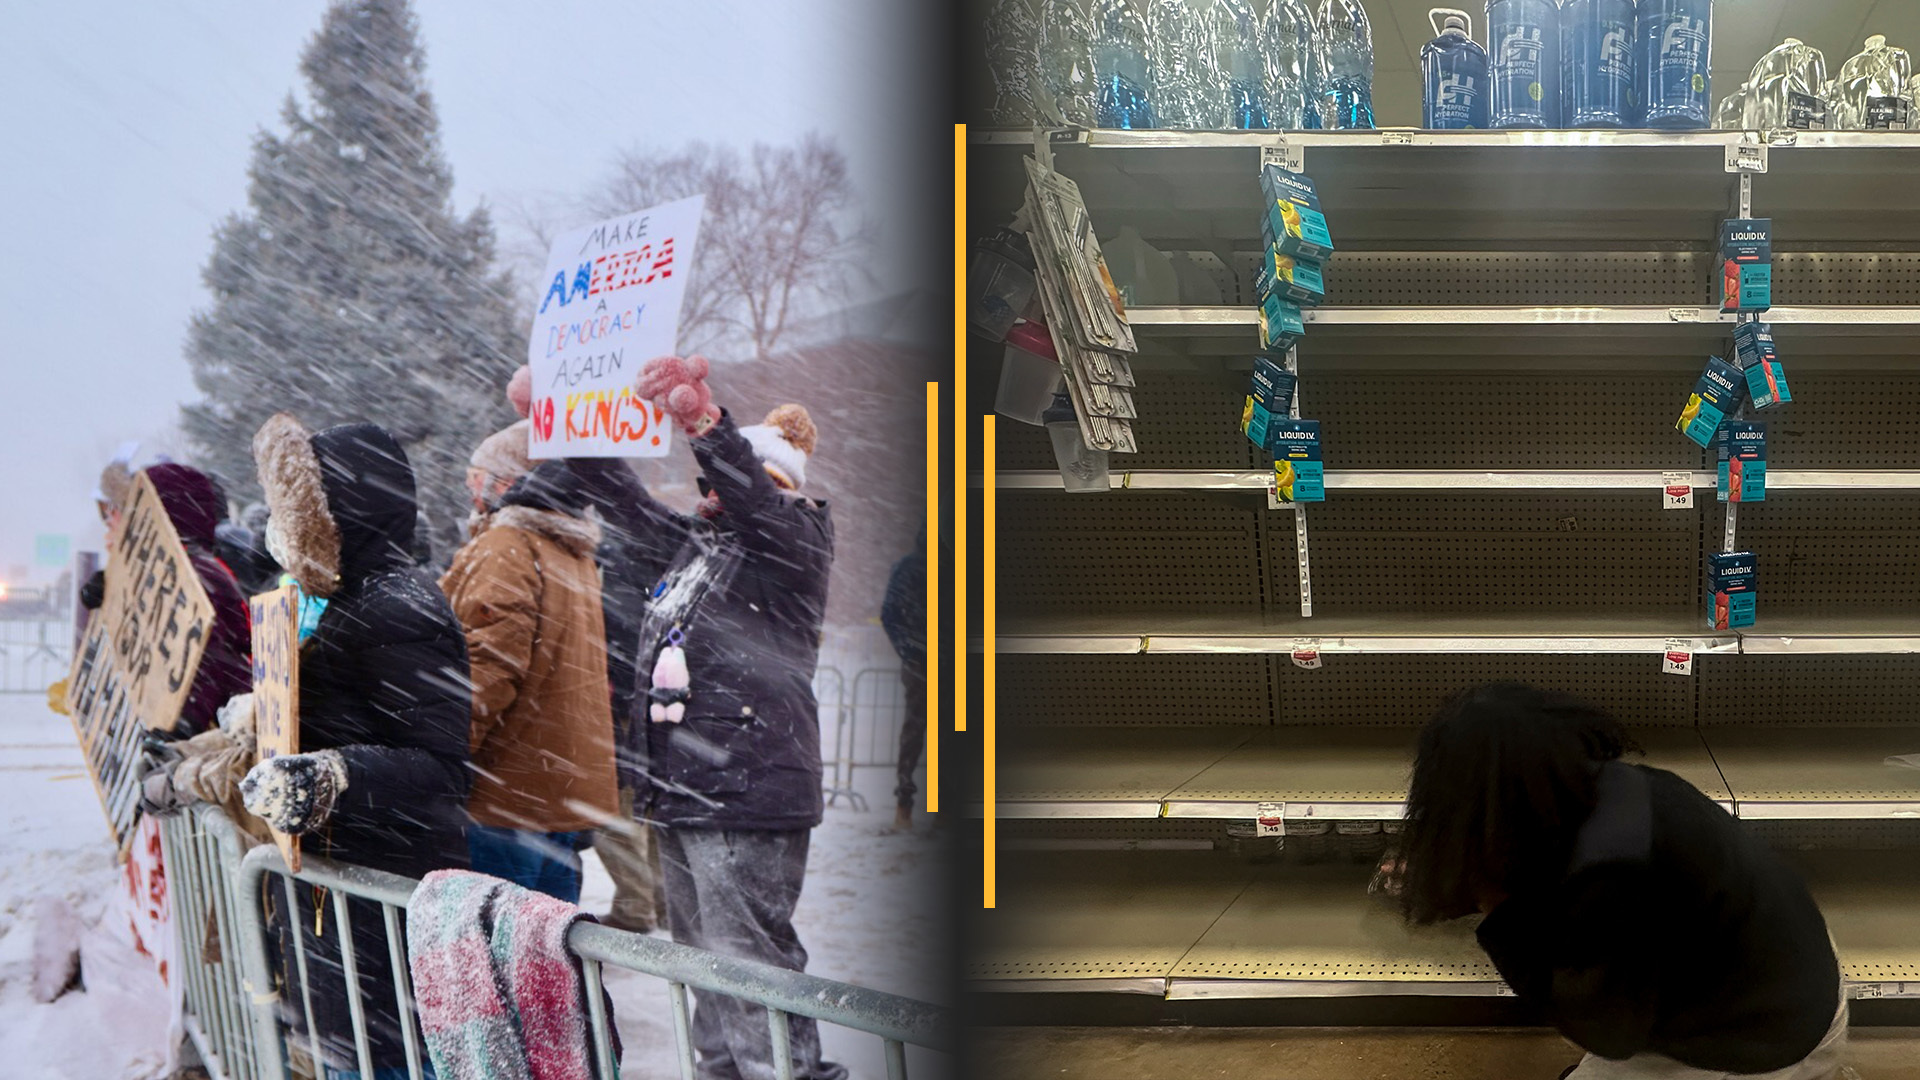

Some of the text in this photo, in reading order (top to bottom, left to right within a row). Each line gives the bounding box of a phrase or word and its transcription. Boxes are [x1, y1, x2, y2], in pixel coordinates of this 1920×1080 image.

[1669, 50, 1699, 60] PERFECT
[1660, 58, 1697, 67] HYDRATION
[1497, 68, 1535, 77] HYDRATION
[1442, 104, 1470, 112] PERFECT
[1277, 175, 1304, 190] LIQUID
[580, 216, 650, 255] MAKE
[1731, 232, 1757, 241] LIQUID
[539, 237, 674, 315] AMERICA
[595, 298, 608, 314] A
[547, 303, 646, 358] DEMOCRACY
[552, 347, 624, 389] AGAIN
[1706, 369, 1727, 387] LIQUID
[532, 385, 664, 446] NO KINGS!
[1279, 431, 1306, 439] LIQUID
[1735, 432, 1757, 440] LIQUID
[1670, 496, 1687, 504] 1.49
[1721, 566, 1744, 576] LIQUID
[119, 488, 203, 694] WHERE'S
[1669, 662, 1685, 671] 1.49
